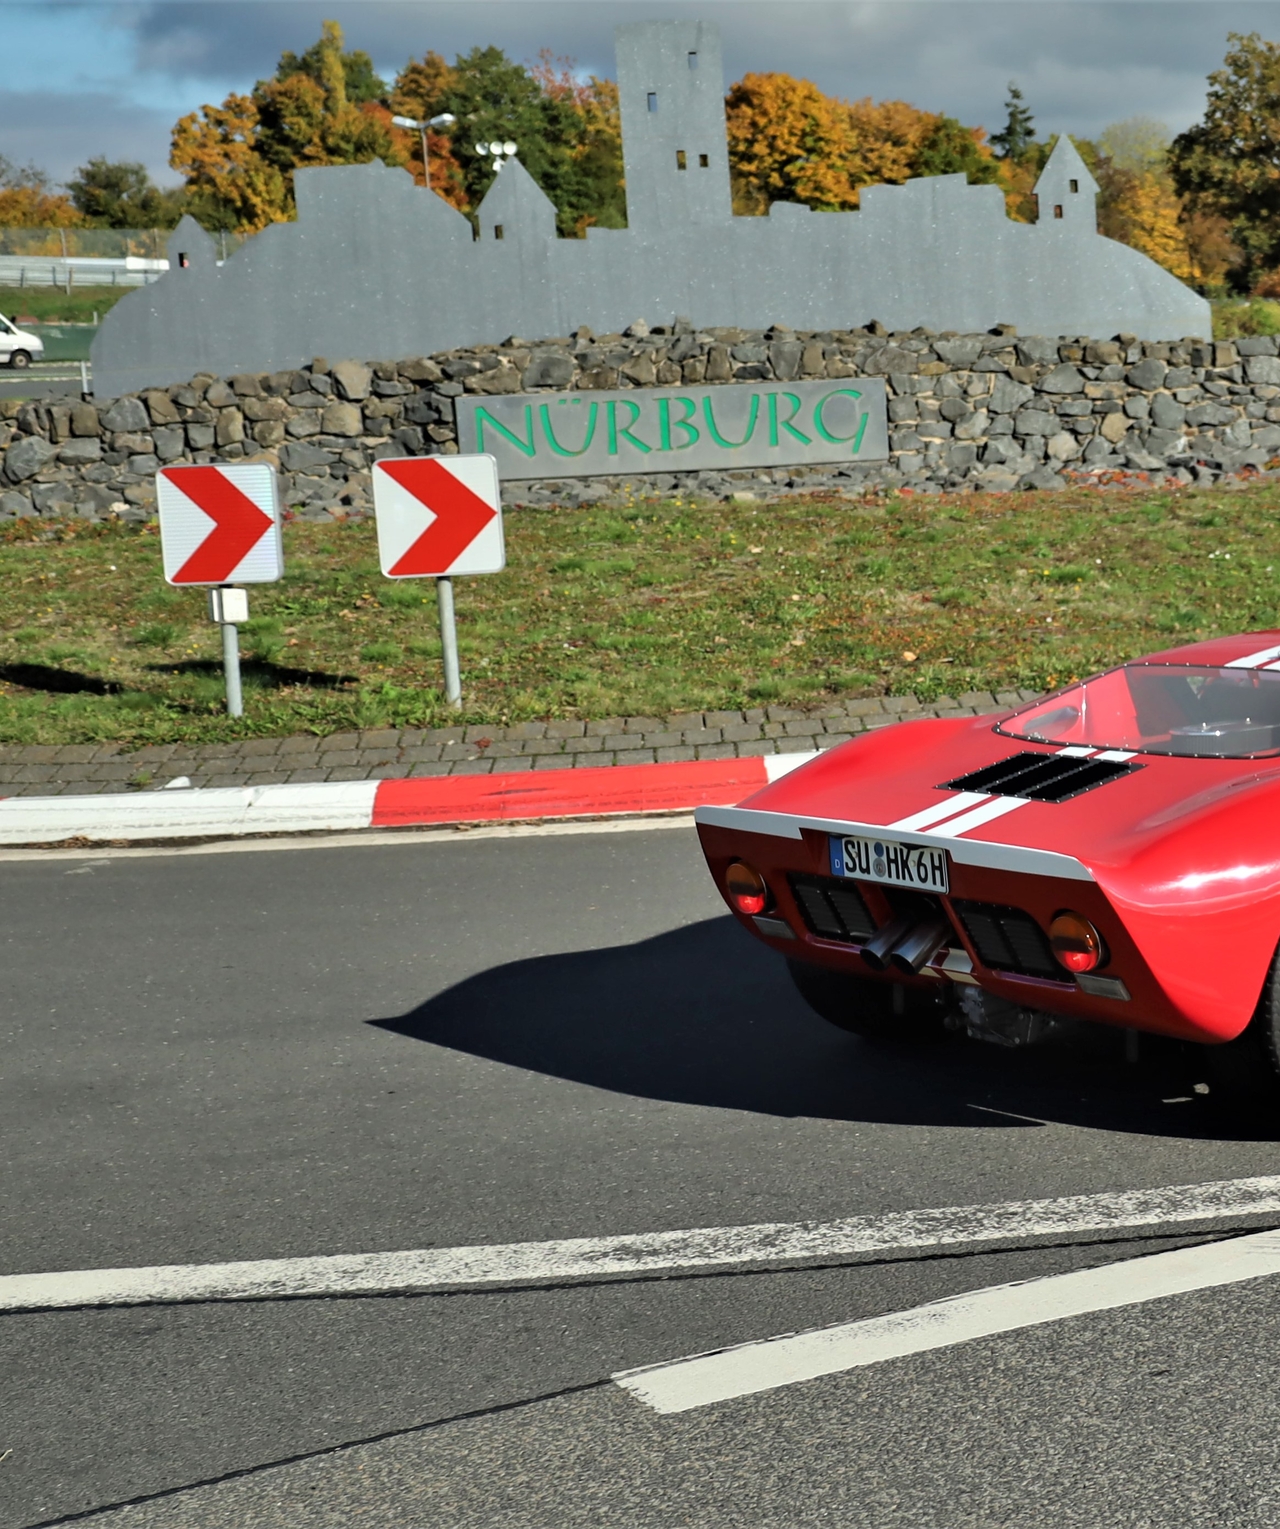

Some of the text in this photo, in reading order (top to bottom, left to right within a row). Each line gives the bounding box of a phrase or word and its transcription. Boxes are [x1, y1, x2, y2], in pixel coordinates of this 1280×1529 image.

[474, 388, 869, 458] NÜRBURG
[843, 840, 945, 887] SU HK 6H
